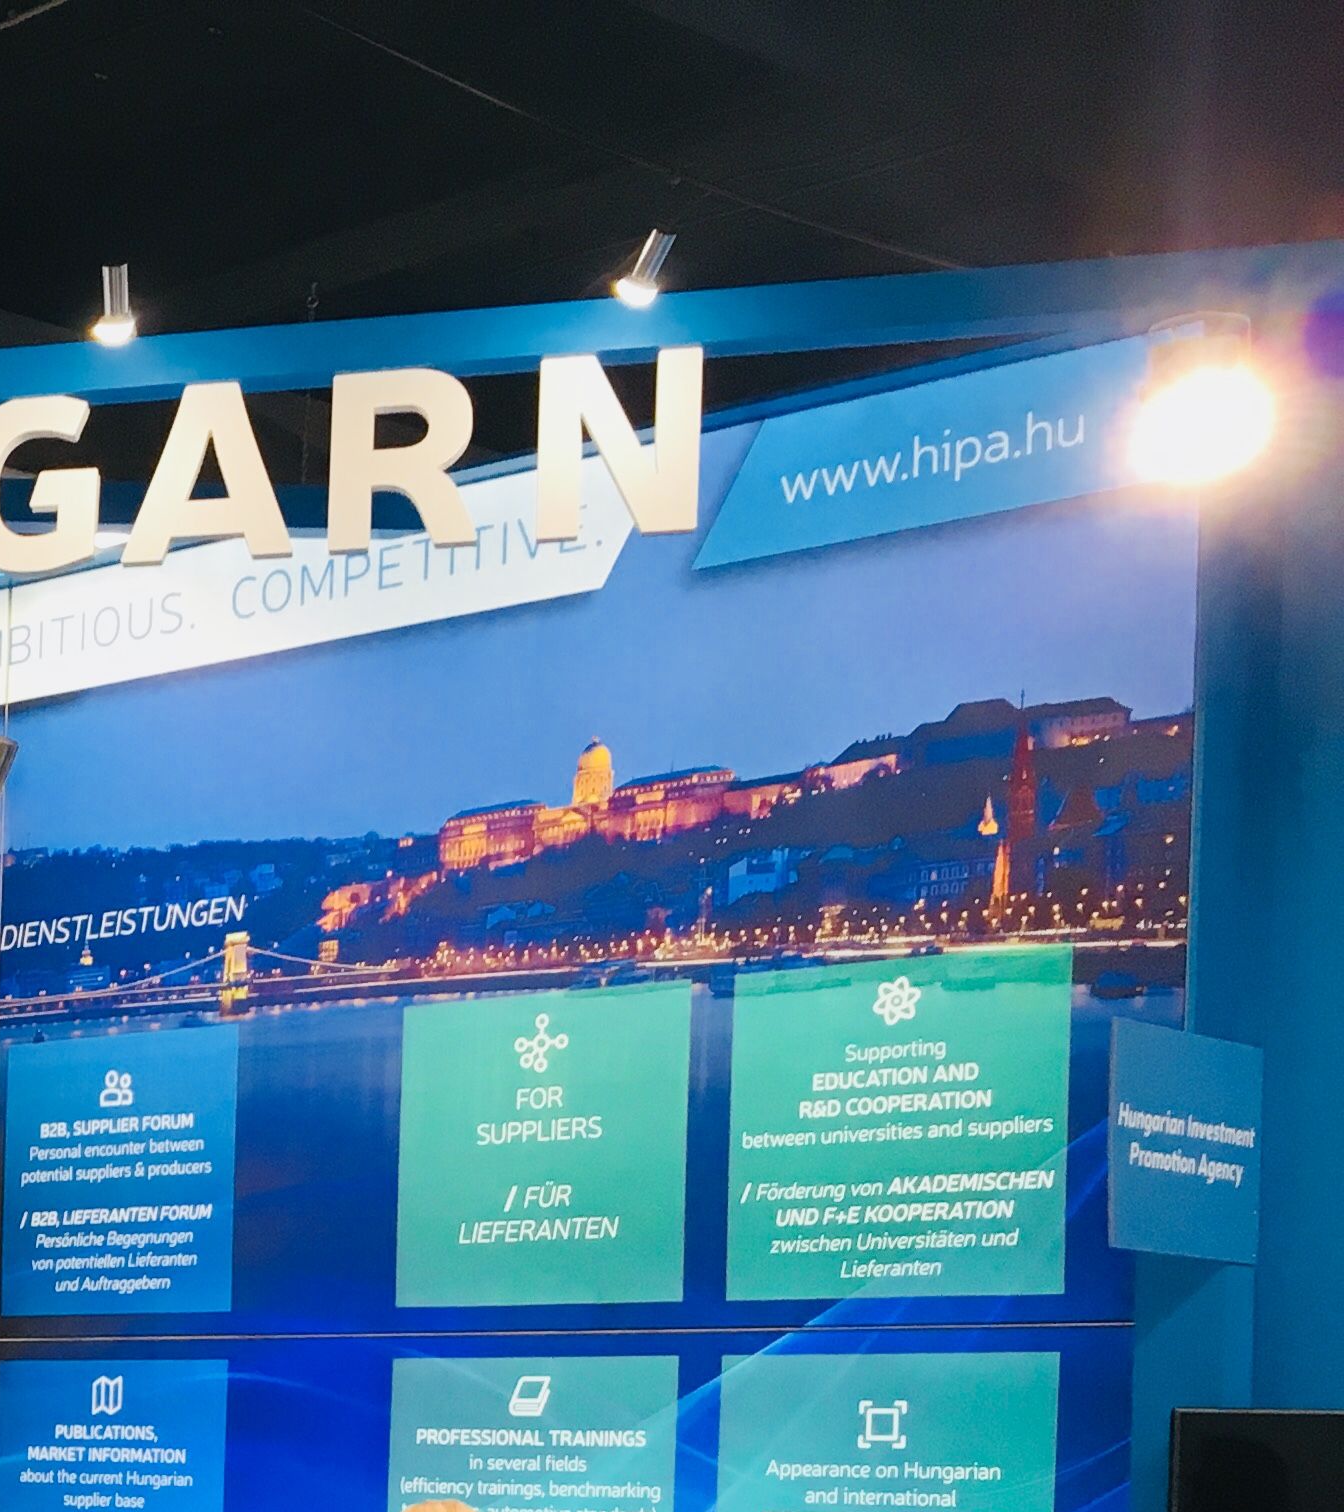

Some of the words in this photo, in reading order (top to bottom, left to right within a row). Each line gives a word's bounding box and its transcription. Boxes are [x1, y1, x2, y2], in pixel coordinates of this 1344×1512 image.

[780, 410, 1085, 504] www.hipa.hu
[1, 894, 245, 951] DIENSTLEISTUNGEN
[845, 1039, 946, 1065] Supporting
[813, 1066, 928, 1091] EDUCATION
[933, 1063, 979, 1082] AND
[516, 1086, 563, 1110] FOR
[799, 1100, 840, 1119] R&D
[845, 1090, 992, 1116] COOPERATION
[40, 1123, 70, 1140] B2B,
[73, 1118, 140, 1137] SUPPLIER
[142, 1113, 194, 1132] FORUM
[477, 1116, 602, 1145] SUPPLIERS
[742, 1130, 815, 1149] between
[821, 1123, 922, 1145] universities
[927, 1119, 962, 1139] and
[968, 1116, 1053, 1141] suppliers
[1118, 1102, 1184, 1137] Hungarian
[1187, 1115, 1255, 1148] Investment
[29, 1144, 81, 1161] Personal
[84, 1141, 145, 1157] encounter
[148, 1137, 204, 1155] between
[21, 1166, 73, 1187] potential
[75, 1163, 132, 1183] suppliers
[134, 1162, 145, 1178] &
[147, 1159, 211, 1179] producers
[1130, 1142, 1196, 1174] Promotion
[1198, 1154, 1244, 1188] Agency
[524, 1181, 572, 1208] FÜR
[756, 1180, 845, 1202] Förderung
[851, 1183, 883, 1197] von
[887, 1170, 1054, 1195] AKADEMISCHEN
[31, 1211, 59, 1228] B2B,
[62, 1205, 158, 1227] LIEFERANTEN
[159, 1204, 212, 1222] FORUM
[775, 1208, 819, 1227] UND
[823, 1206, 859, 1224] F+E
[864, 1200, 1014, 1222] KOOPERATION
[36, 1231, 104, 1249] Persönliche
[107, 1229, 193, 1248] Begegnungen
[459, 1216, 619, 1244] LIEFERANTEN
[770, 1236, 851, 1254] zwischen
[857, 1231, 976, 1251] Universitäten
[982, 1228, 1019, 1247] und
[31, 1257, 53, 1271] von
[55, 1253, 124, 1274] potentiellen
[127, 1252, 197, 1269] Lieferanten
[840, 1260, 942, 1279] Lieferanten
[55, 1277, 79, 1292] und
[81, 1275, 170, 1294] Auftraggebern
[55, 1424, 158, 1442] PUBLICATIONS,
[416, 1428, 544, 1446] PROFESSIONAL
[549, 1429, 646, 1447] TRAININGS
[28, 1446, 85, 1462] MARKET
[88, 1448, 186, 1463] INFORMATION
[469, 1455, 483, 1470] in
[487, 1456, 541, 1471] several
[546, 1456, 587, 1472] fields
[20, 1469, 54, 1484] about
[57, 1470, 76, 1484] the
[80, 1471, 122, 1485] current
[126, 1471, 192, 1489] Hungarian
[766, 1460, 871, 1479] Appearance
[875, 1464, 898, 1478] on
[904, 1462, 1001, 1484] Hungarian
[63, 1492, 112, 1509] supplier
[115, 1494, 144, 1509] base
[401, 1477, 473, 1497] (efficiency
[477, 1480, 544, 1497] trainings,
[549, 1482, 661, 1503] benchmarking
[805, 1488, 838, 1504] and
[843, 1490, 956, 1507] international
